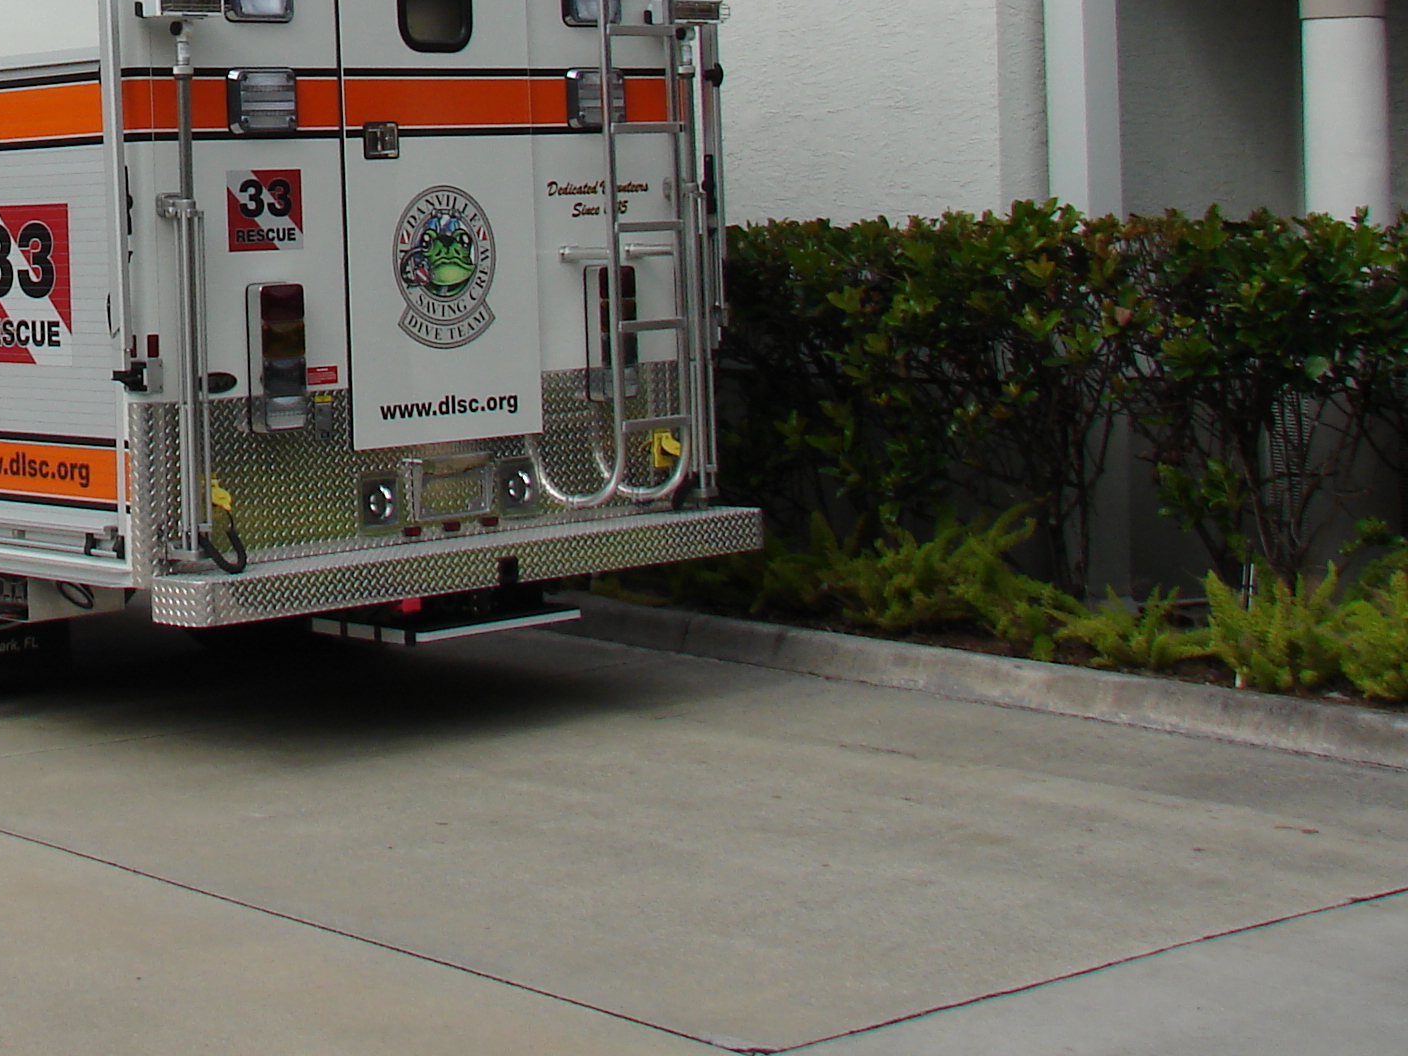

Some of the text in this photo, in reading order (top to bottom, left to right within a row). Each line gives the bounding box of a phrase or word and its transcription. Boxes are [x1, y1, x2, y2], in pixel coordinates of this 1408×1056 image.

[238, 178, 292, 218] 33
[547, 180, 599, 196] Dedicated
[406, 194, 481, 230] DANVILLE
[572, 202, 600, 217] Since
[236, 227, 297, 243] RESCUE
[415, 245, 490, 318] SAVING CREW
[408, 310, 486, 341] DIVE TEAM
[380, 394, 519, 420] www.dlsc.org
[24, 636, 39, 649] FL
